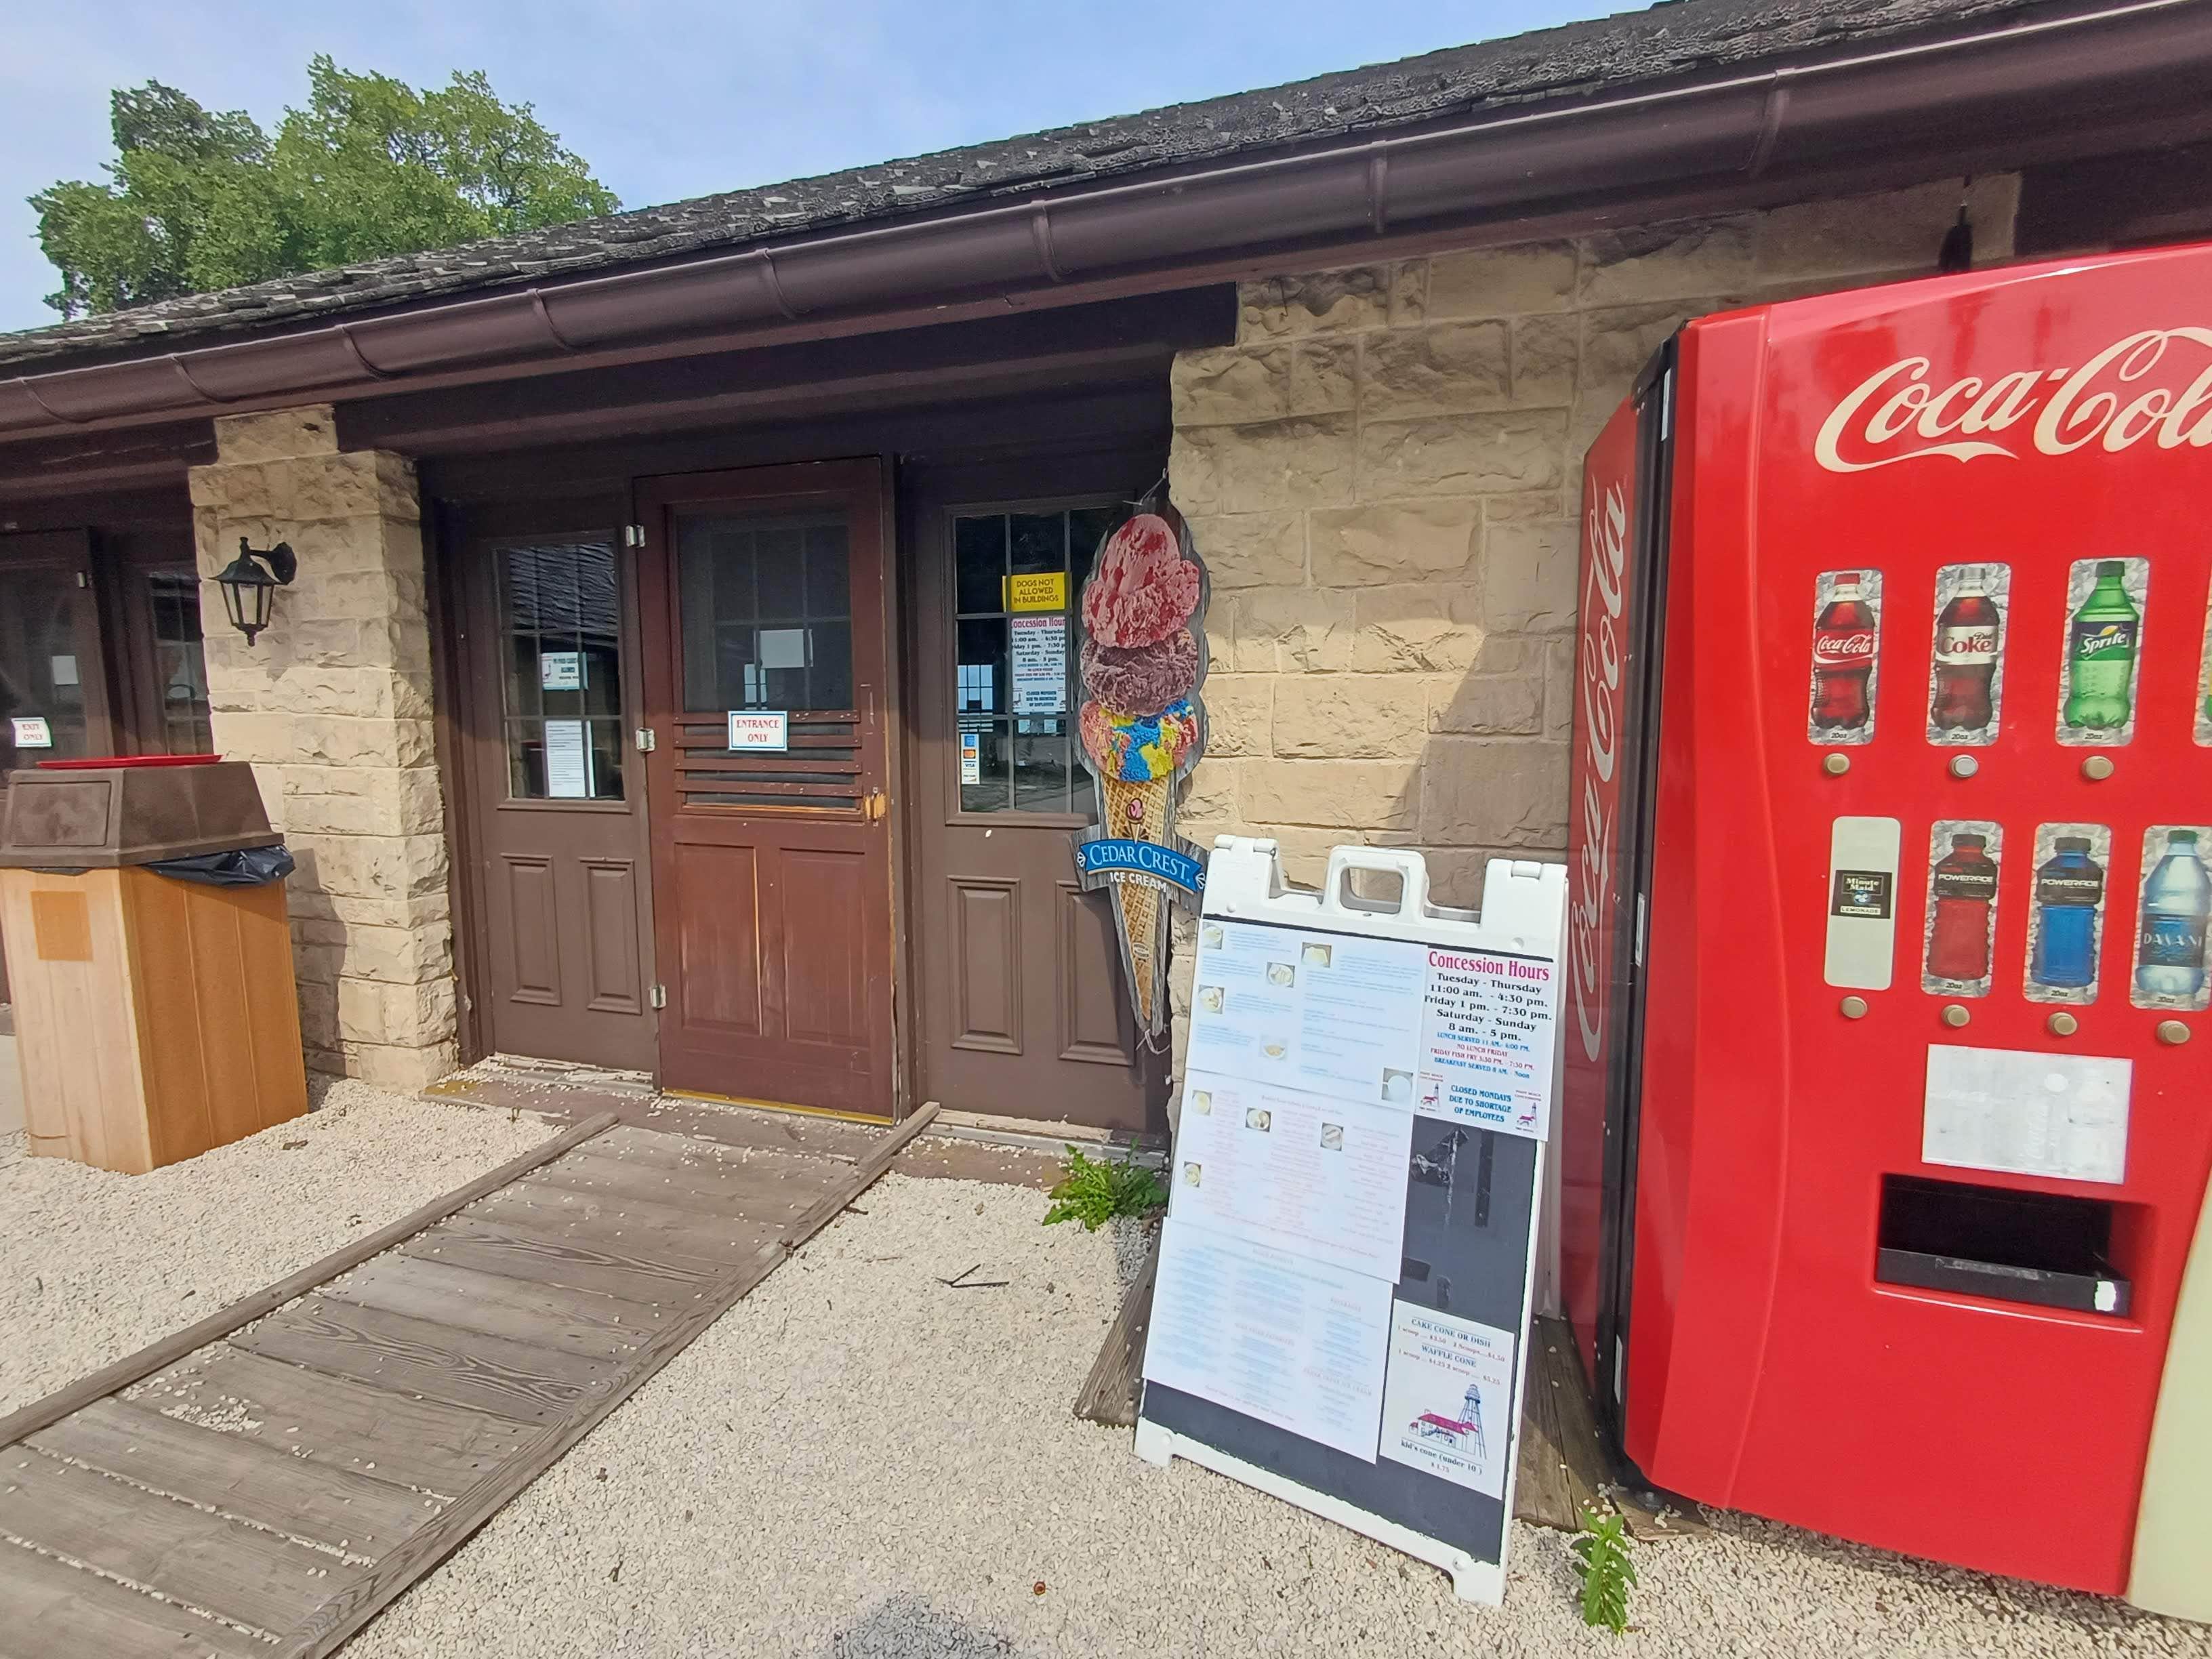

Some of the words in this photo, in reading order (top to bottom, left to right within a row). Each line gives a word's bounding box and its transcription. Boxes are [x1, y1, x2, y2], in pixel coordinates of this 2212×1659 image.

[1019, 587, 1053, 596] ALLOWED
[1022, 595, 1059, 603] BUILDINGS
[1012, 617, 1047, 628] oncession
[1817, 634, 1872, 655] Coca-Cola
[1940, 636, 1992, 654] Coke
[2080, 632, 2127, 654] Sprite
[737, 720, 779, 729] ENTRANCE
[747, 733, 769, 742] ONLY
[1572, 472, 1626, 1062] Coca-Cola
[1089, 844, 1138, 866] CEDAR
[1109, 872, 1126, 882] ICE
[1128, 873, 1167, 893] CREAM
[1845, 877, 1879, 886] Minute
[1849, 883, 1875, 891] Maid
[1938, 874, 1994, 882] POWERADE
[2041, 878, 2099, 888] POWERADE
[1429, 951, 1504, 975] Concession
[1509, 960, 1550, 981] Hours
[1437, 972, 1480, 987] Tuesday
[1491, 980, 1542, 995] Thursday
[1431, 984, 1460, 995] 11:00
[1462, 989, 1483, 998] am.
[1498, 993, 1523, 1004] 4:30
[1527, 998, 1549, 1007] pm.
[1424, 995, 1456, 1007] Friday
[1470, 1003, 1490, 1011] pm.
[1502, 1006, 1527, 1017] 7:30
[1530, 1011, 1552, 1021] pm.
[1436, 1008, 1484, 1025] Saturday
[1495, 1017, 1537, 1032] Sunday
[1437, 1031, 1456, 1040] LUNCH
[1457, 1035, 1480, 1044] SERVED
[1448, 1023, 1456, 1031] 8
[1458, 1025, 1478, 1034] am.
[1500, 1031, 1521, 1042] pm.
[1431, 1047, 1450, 1056] FRIDAY
[1467, 1044, 1486, 1053] LUNCH
[1487, 1048, 1508, 1057] FRIDAY
[1434, 1057, 1467, 1067] BREAKFAST
[1468, 1062, 1491, 1071] SERVED
[1450, 1084, 1477, 1096] CLOSED
[1479, 1090, 1512, 1103] MONDAYS
[1449, 1094, 1462, 1103] DUE
[1465, 1097, 1474, 1105] TO
[1475, 1099, 1512, 1113] SHORTAGE
[1454, 1106, 1464, 1114] OF
[1465, 1109, 1504, 1123] EMPLOYEES
[1411, 1318, 1433, 1331] CAKE
[1433, 1324, 1455, 1338] CONE
[1457, 1332, 1469, 1341] OR
[1471, 1336, 1491, 1348] DISH
[1421, 1345, 1453, 1361] WAFFLE
[1454, 1355, 1477, 1368] CONE
[1401, 1439, 1418, 1450] kid's
[1420, 1448, 1437, 1458] cone
[1439, 1453, 1465, 1467] (under
[1467, 1462, 1477, 1472] 10
